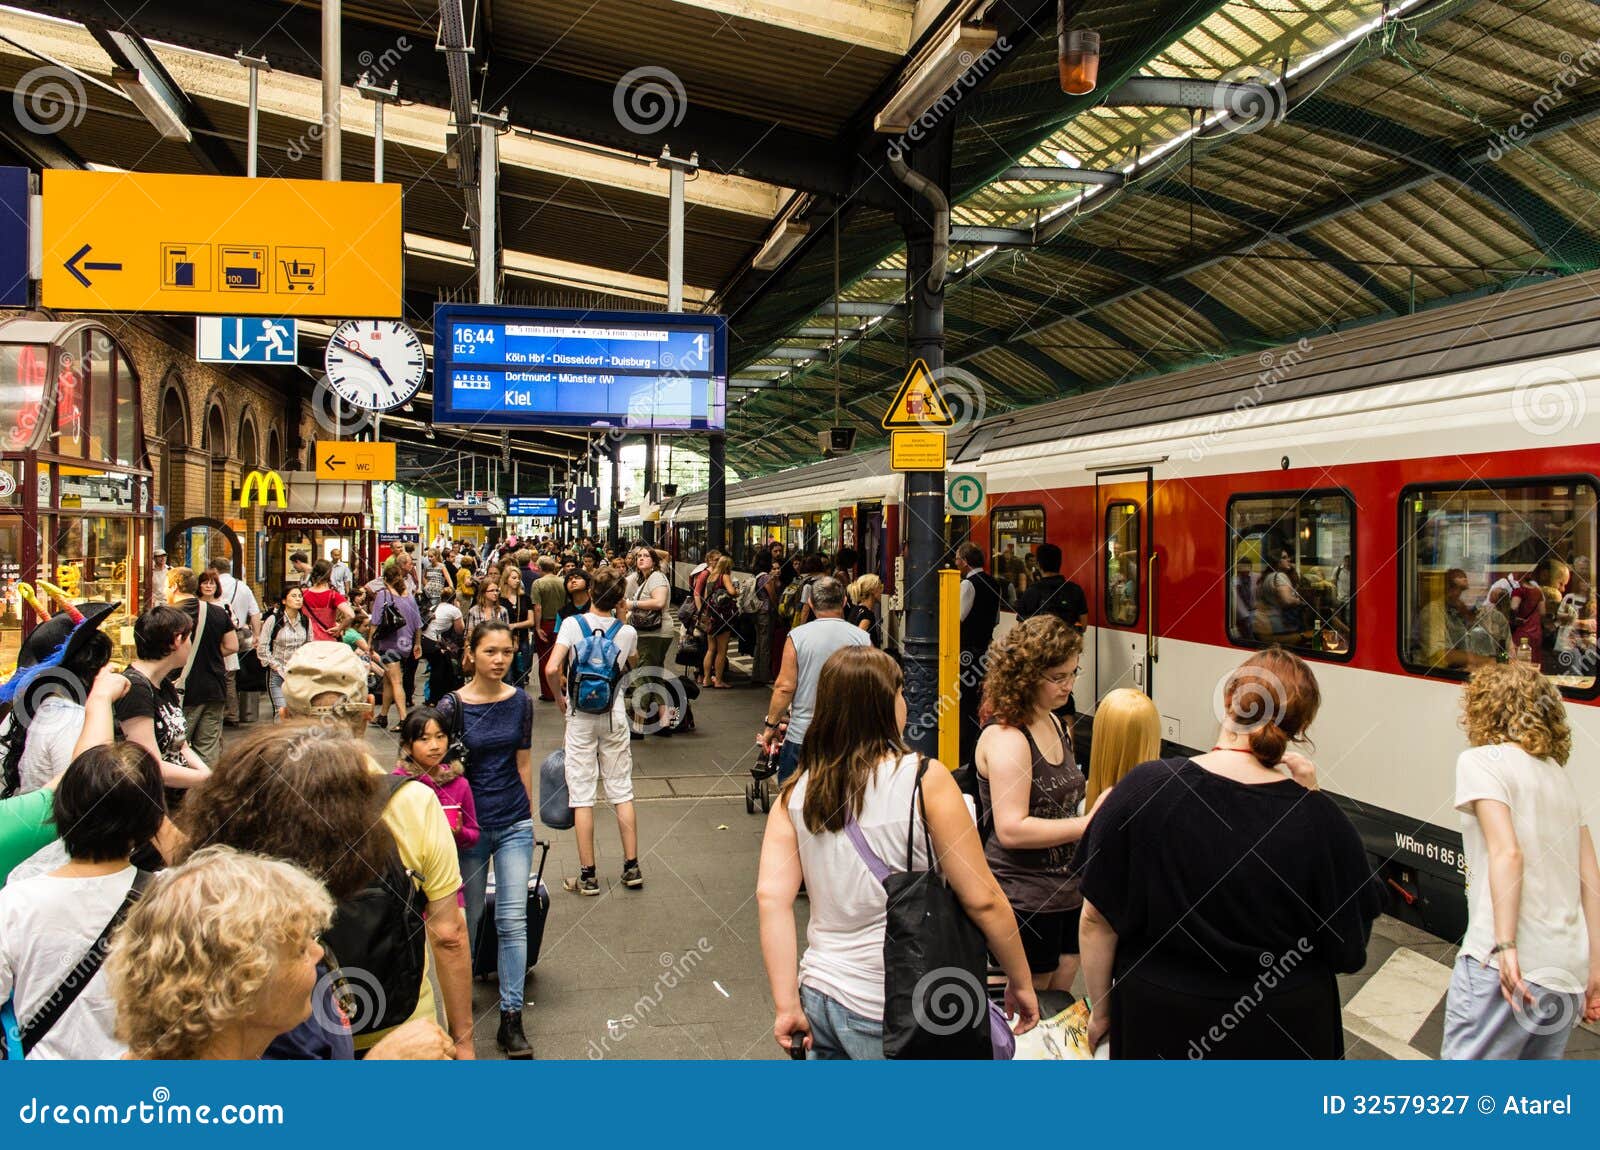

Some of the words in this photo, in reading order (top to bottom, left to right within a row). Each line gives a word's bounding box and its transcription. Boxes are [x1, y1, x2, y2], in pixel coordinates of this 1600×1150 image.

[227, 275, 242, 284] 100
[455, 328, 495, 344] 16:44
[453, 344, 466, 354] EC
[468, 345, 475, 354] 2
[692, 334, 703, 361] 1
[505, 352, 527, 363] Köln
[528, 353, 545, 364] Hbf
[553, 354, 603, 365] Düsseldorf
[611, 357, 651, 369] Duisburg
[505, 372, 551, 383] Dortmund
[558, 373, 596, 384] Münster
[599, 375, 615, 385] (W)
[505, 391, 532, 406] Kiel
[356, 463, 370, 471] WC
[590, 488, 598, 506] 1
[456, 508, 469, 517] 2-5
[564, 498, 576, 514] C
[287, 517, 339, 525] McDonald's
[1395, 831, 1424, 856] WRm
[1426, 842, 1439, 861] 61
[1440, 847, 1455, 866] 85
